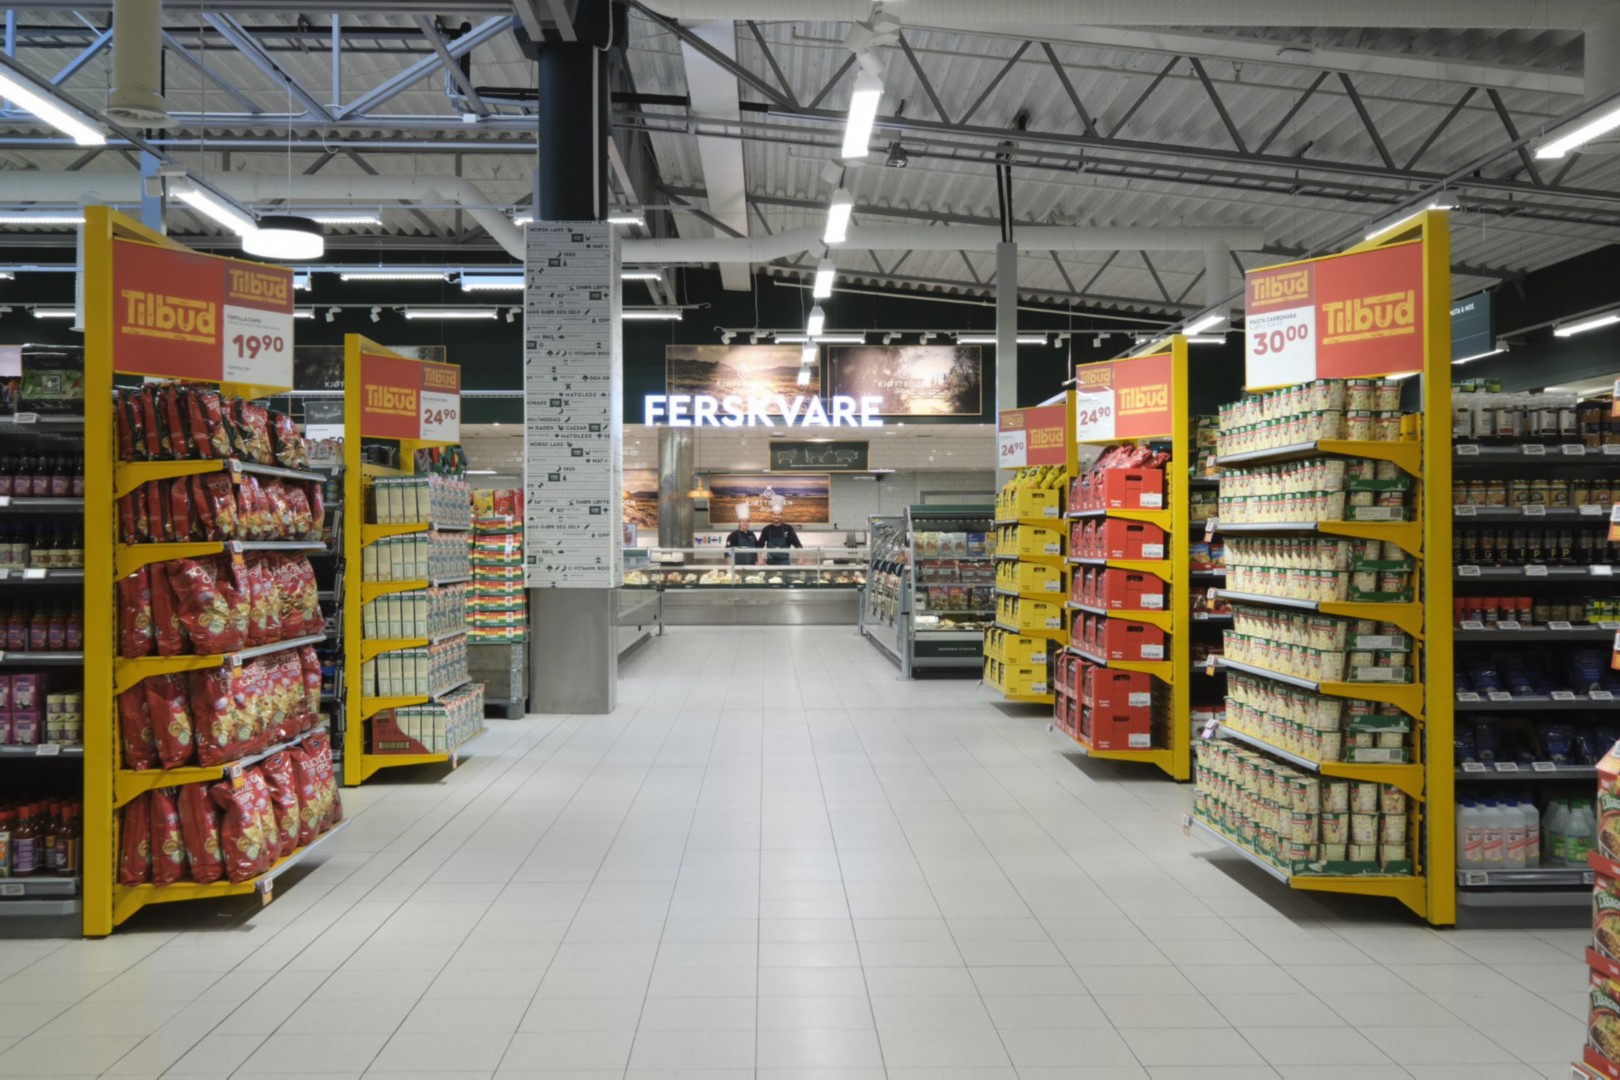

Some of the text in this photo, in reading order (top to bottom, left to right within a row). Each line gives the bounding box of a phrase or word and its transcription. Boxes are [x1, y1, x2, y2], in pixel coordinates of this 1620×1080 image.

[229, 268, 288, 301] Tilbud
[1251, 270, 1309, 302] Tilbud
[121, 288, 216, 336] Tilbud
[1266, 313, 1296, 322] CARBONARA
[1322, 289, 1415, 336] Tilbud
[424, 368, 457, 387] Tilbud
[1079, 368, 1111, 387] Tilbud
[365, 384, 417, 412] Tilbud
[644, 394, 885, 428] FERSKVARE
[1118, 384, 1168, 412] Tilbud
[1029, 428, 1064, 446] Tilbud
